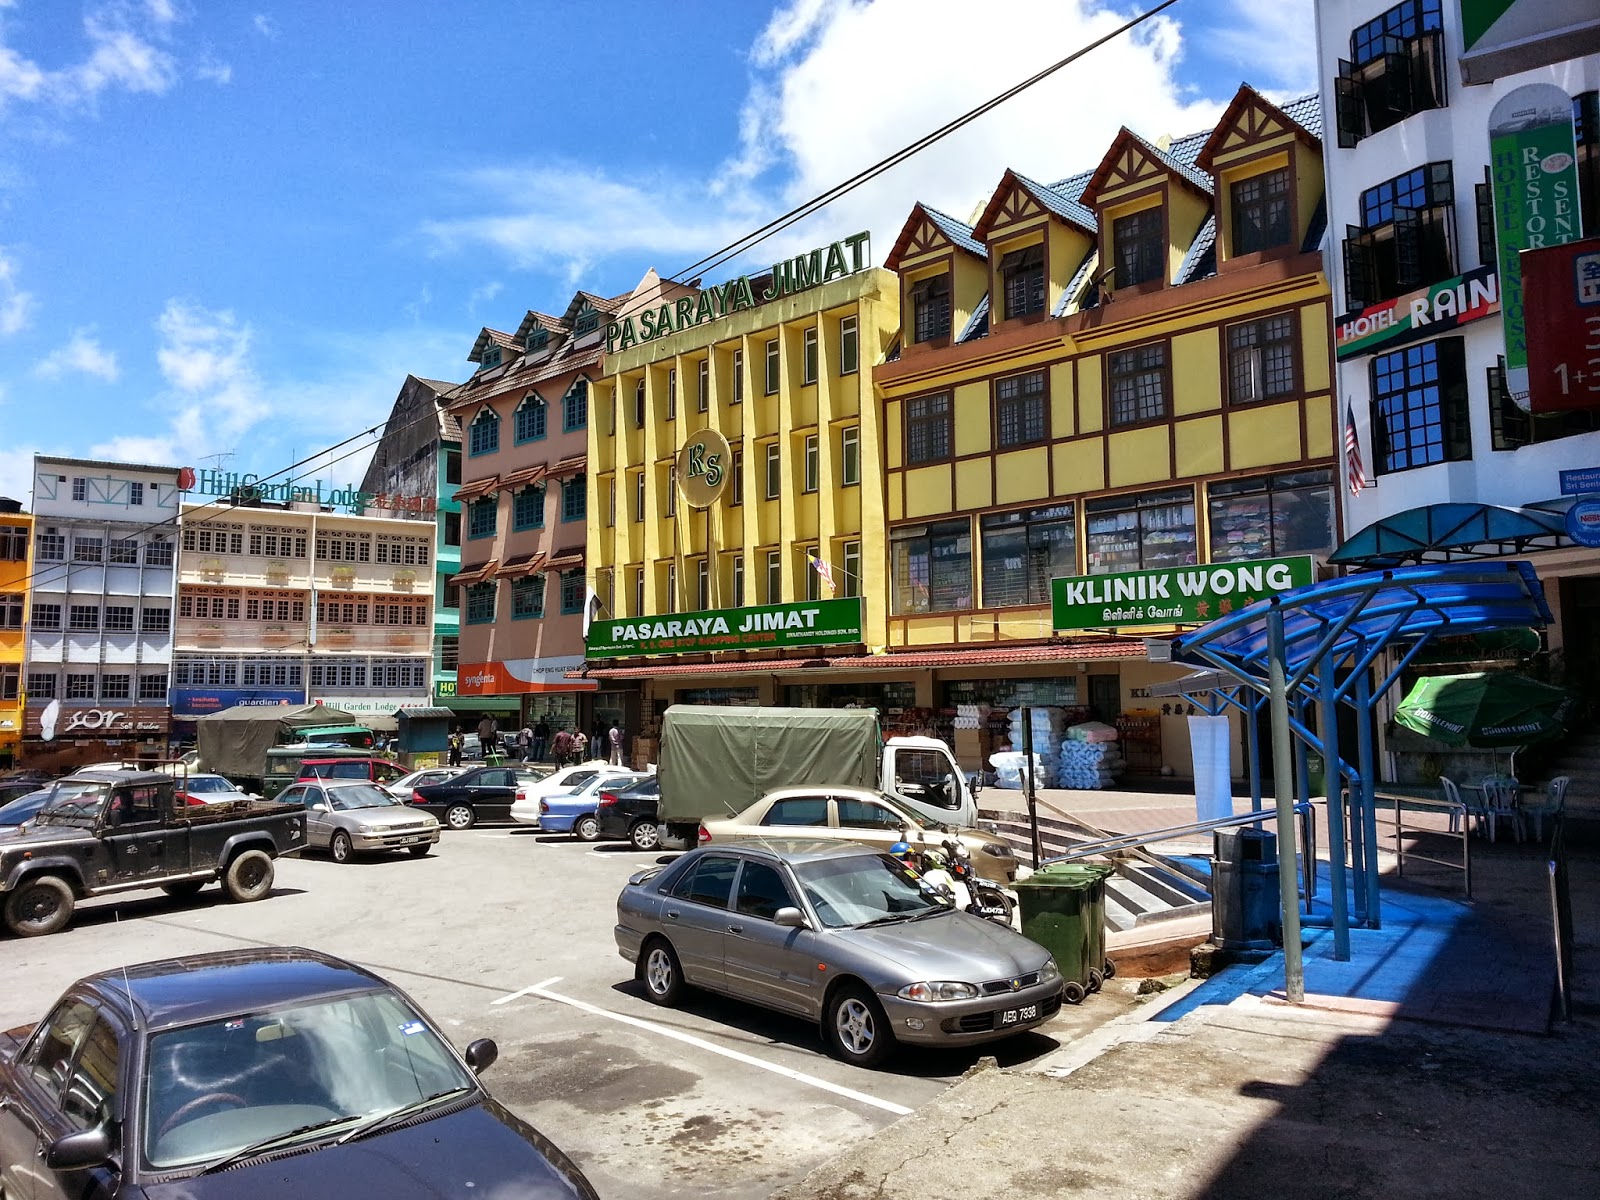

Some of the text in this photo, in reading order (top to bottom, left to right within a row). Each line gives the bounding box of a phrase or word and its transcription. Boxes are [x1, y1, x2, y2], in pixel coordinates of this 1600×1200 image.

[1497, 152, 1519, 230] HOTEL
[606, 230, 871, 354] PASARAYA JIMAT
[1505, 242, 1527, 351] SENTOSA
[1343, 273, 1498, 341] HOTEL RAIN
[1066, 563, 1293, 606] KLINIK WONG
[612, 609, 820, 641] PASARAYA JIMAT
[676, 638, 696, 646] STOP
[698, 635, 740, 645] SHOPPING
[742, 632, 776, 642] CENTER
[440, 682, 457, 692] HO
[465, 672, 495, 687] syngenta
[239, 698, 279, 707] guardian
[326, 702, 341, 711] Hill
[344, 702, 371, 711] Garden
[375, 702, 397, 712] Lodge
[1413, 707, 1465, 734] DOUBLEMINT
